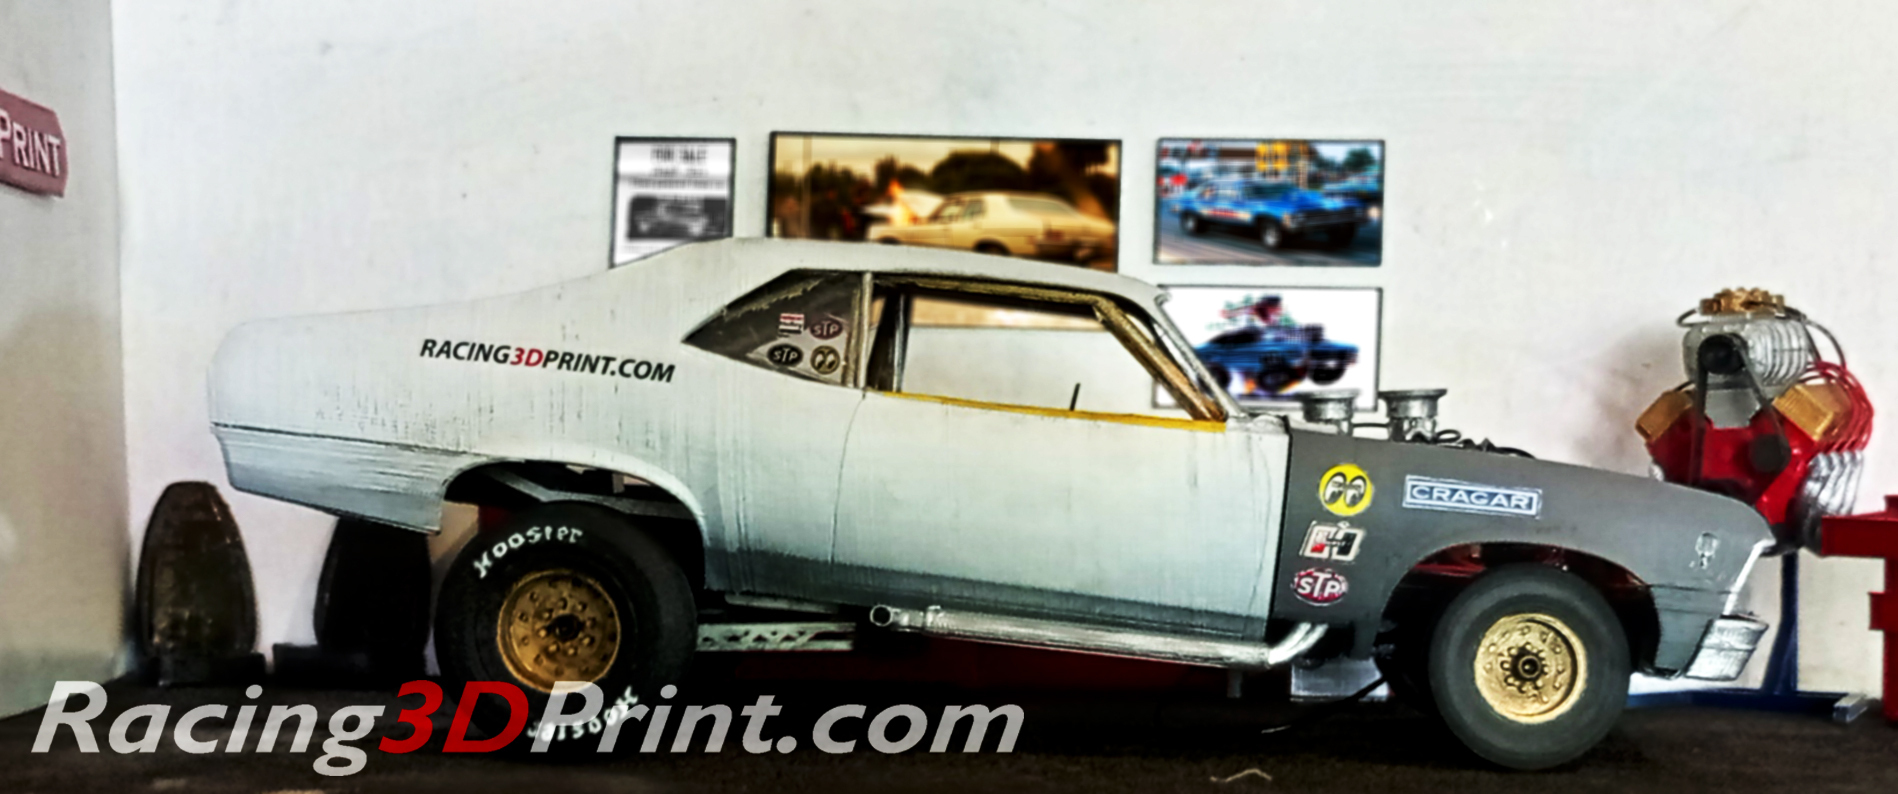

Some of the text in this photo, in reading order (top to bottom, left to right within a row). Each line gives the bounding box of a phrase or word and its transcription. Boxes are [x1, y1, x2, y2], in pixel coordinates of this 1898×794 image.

[0, 108, 60, 177] PRINT
[813, 320, 840, 337] STP
[419, 338, 676, 383] RACING3DPRINT.COM
[772, 347, 799, 362] STP
[1410, 485, 1530, 511] CRAGAR
[1296, 571, 1343, 599] STP
